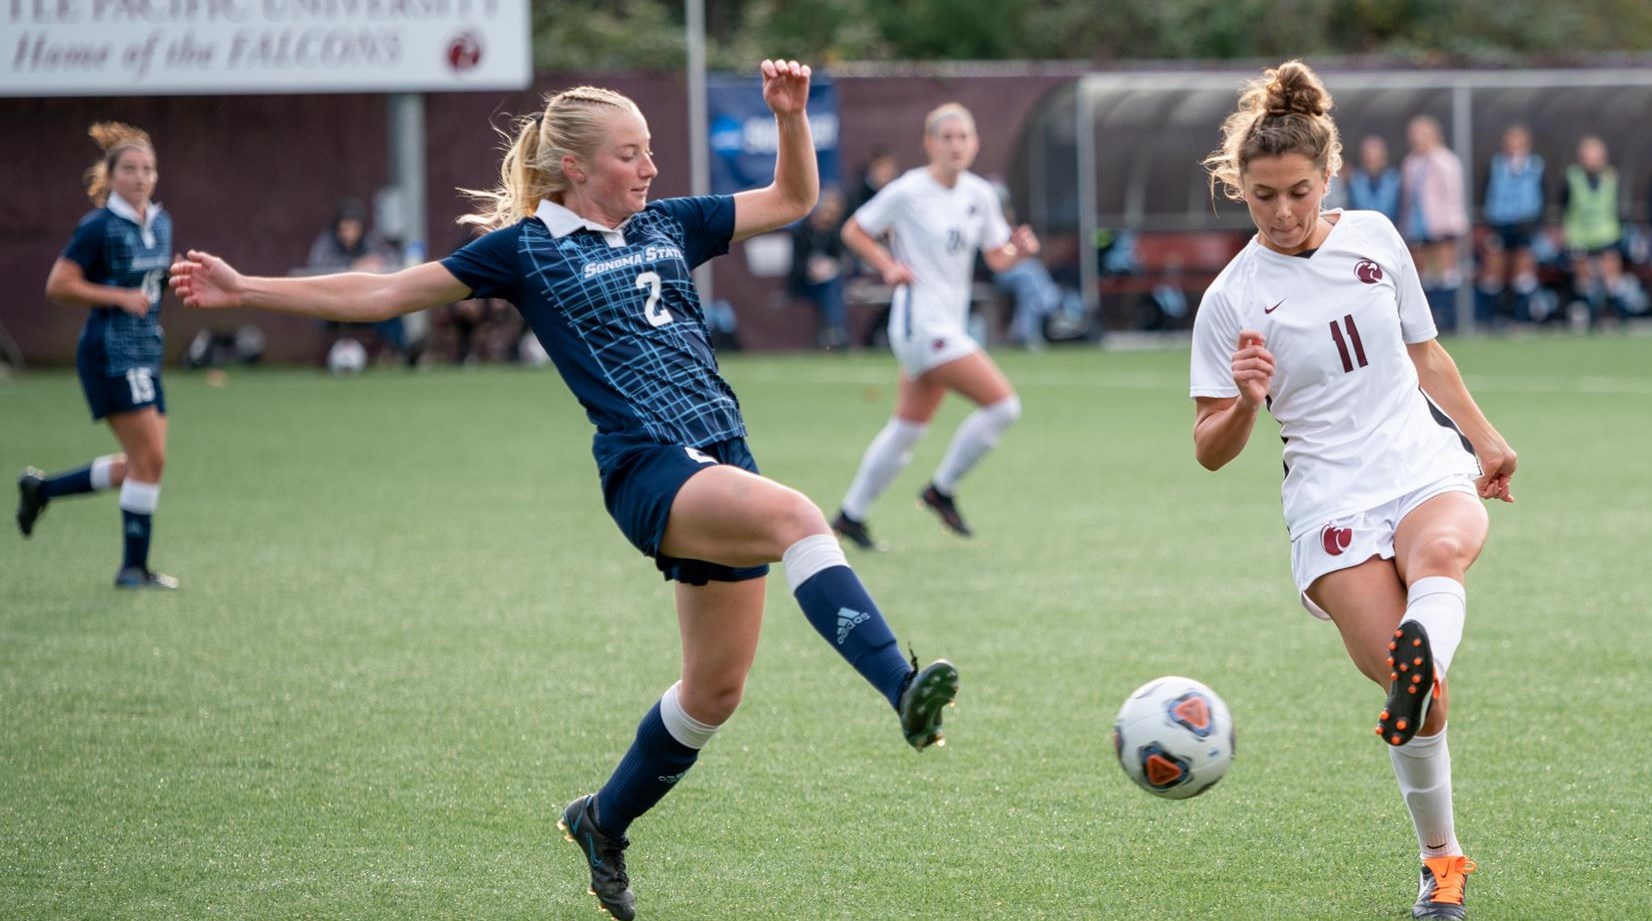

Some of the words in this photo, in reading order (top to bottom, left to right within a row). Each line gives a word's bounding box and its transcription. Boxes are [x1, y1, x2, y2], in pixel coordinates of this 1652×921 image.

[13, 31, 112, 71] Home
[121, 28, 165, 82] of
[164, 29, 215, 70] the
[226, 30, 401, 68] FALCONS
[635, 271, 673, 327] 2
[1329, 313, 1369, 373] 11
[126, 366, 156, 404] 15
[837, 612, 871, 645] adidas
